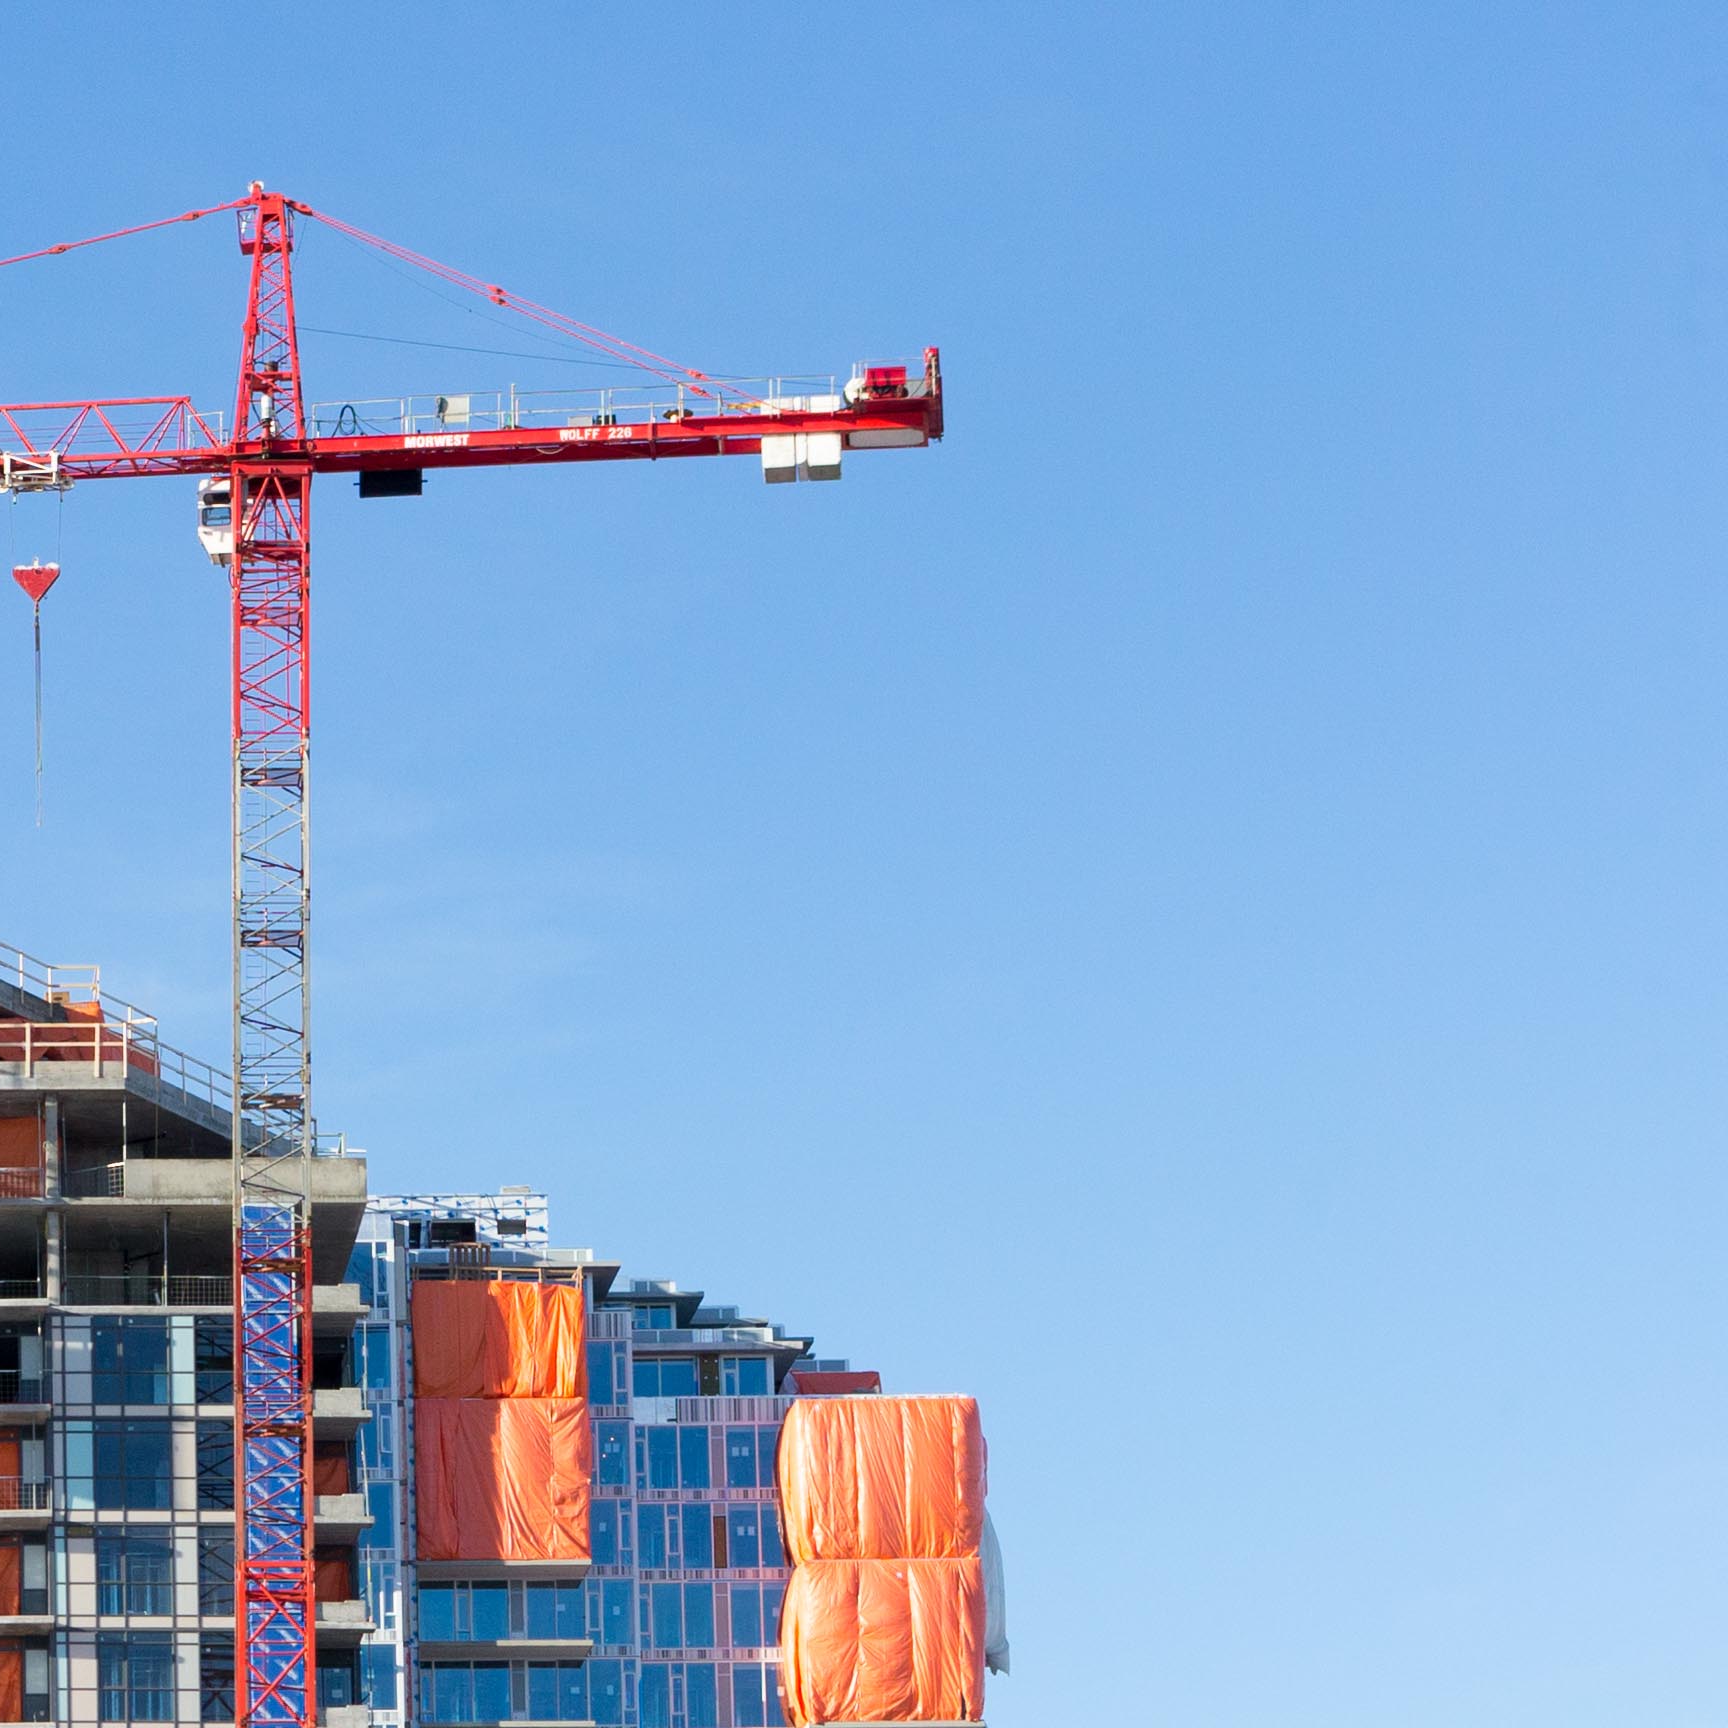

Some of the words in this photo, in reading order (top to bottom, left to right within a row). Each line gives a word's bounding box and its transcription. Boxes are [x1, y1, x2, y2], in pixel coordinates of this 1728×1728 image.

[404, 433, 470, 449] MORWEST
[559, 427, 600, 441] WOLFF
[608, 427, 633, 439] 226
